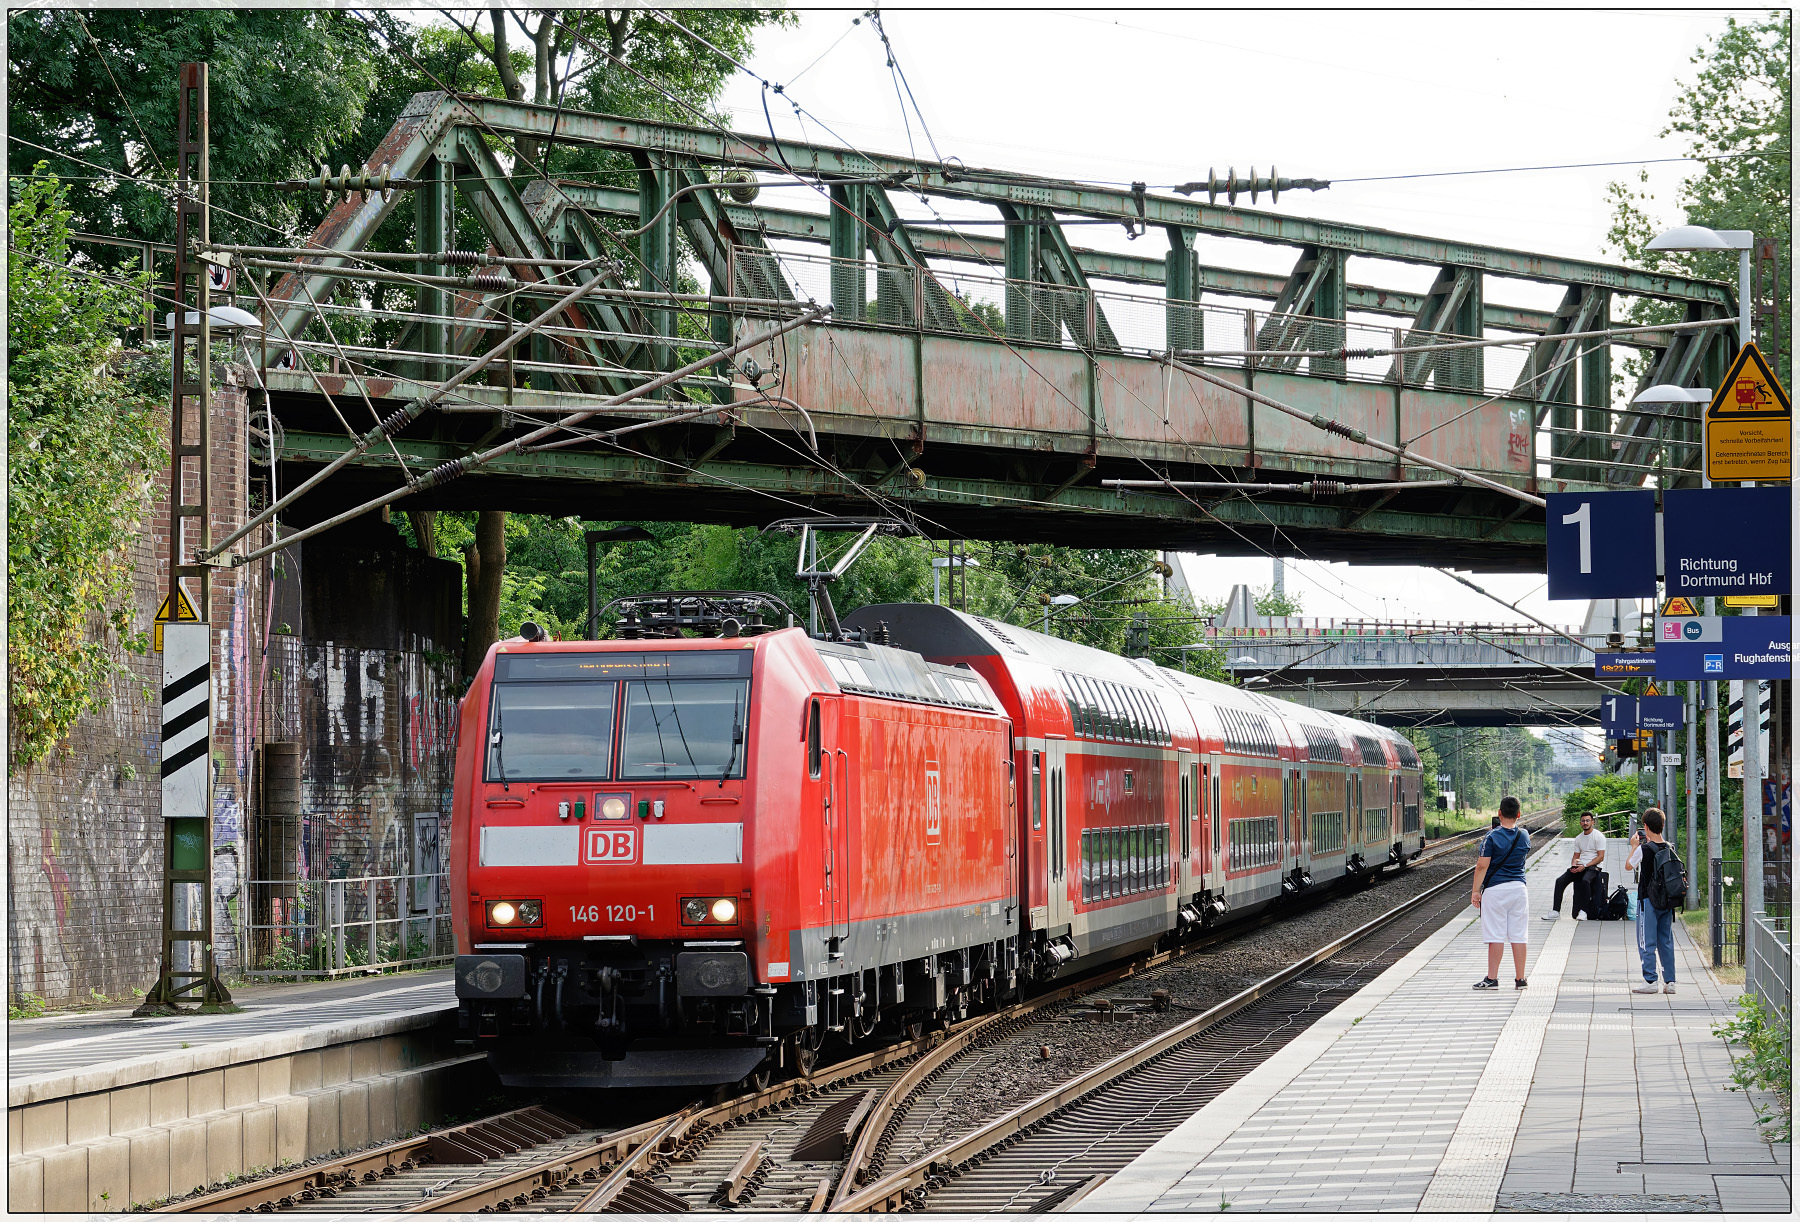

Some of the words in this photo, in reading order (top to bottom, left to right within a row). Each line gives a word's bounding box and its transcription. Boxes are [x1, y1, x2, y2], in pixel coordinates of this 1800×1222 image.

[1562, 502, 1592, 574] 1
[1680, 557, 1738, 572] Richtung
[1680, 574, 1745, 587] Dortmund
[1749, 572, 1773, 586] Hbf
[1605, 697, 1617, 722] 1
[928, 775, 939, 830] DB
[591, 833, 631, 858] DB
[569, 904, 599, 923] 146
[606, 904, 655, 922] 120-1
